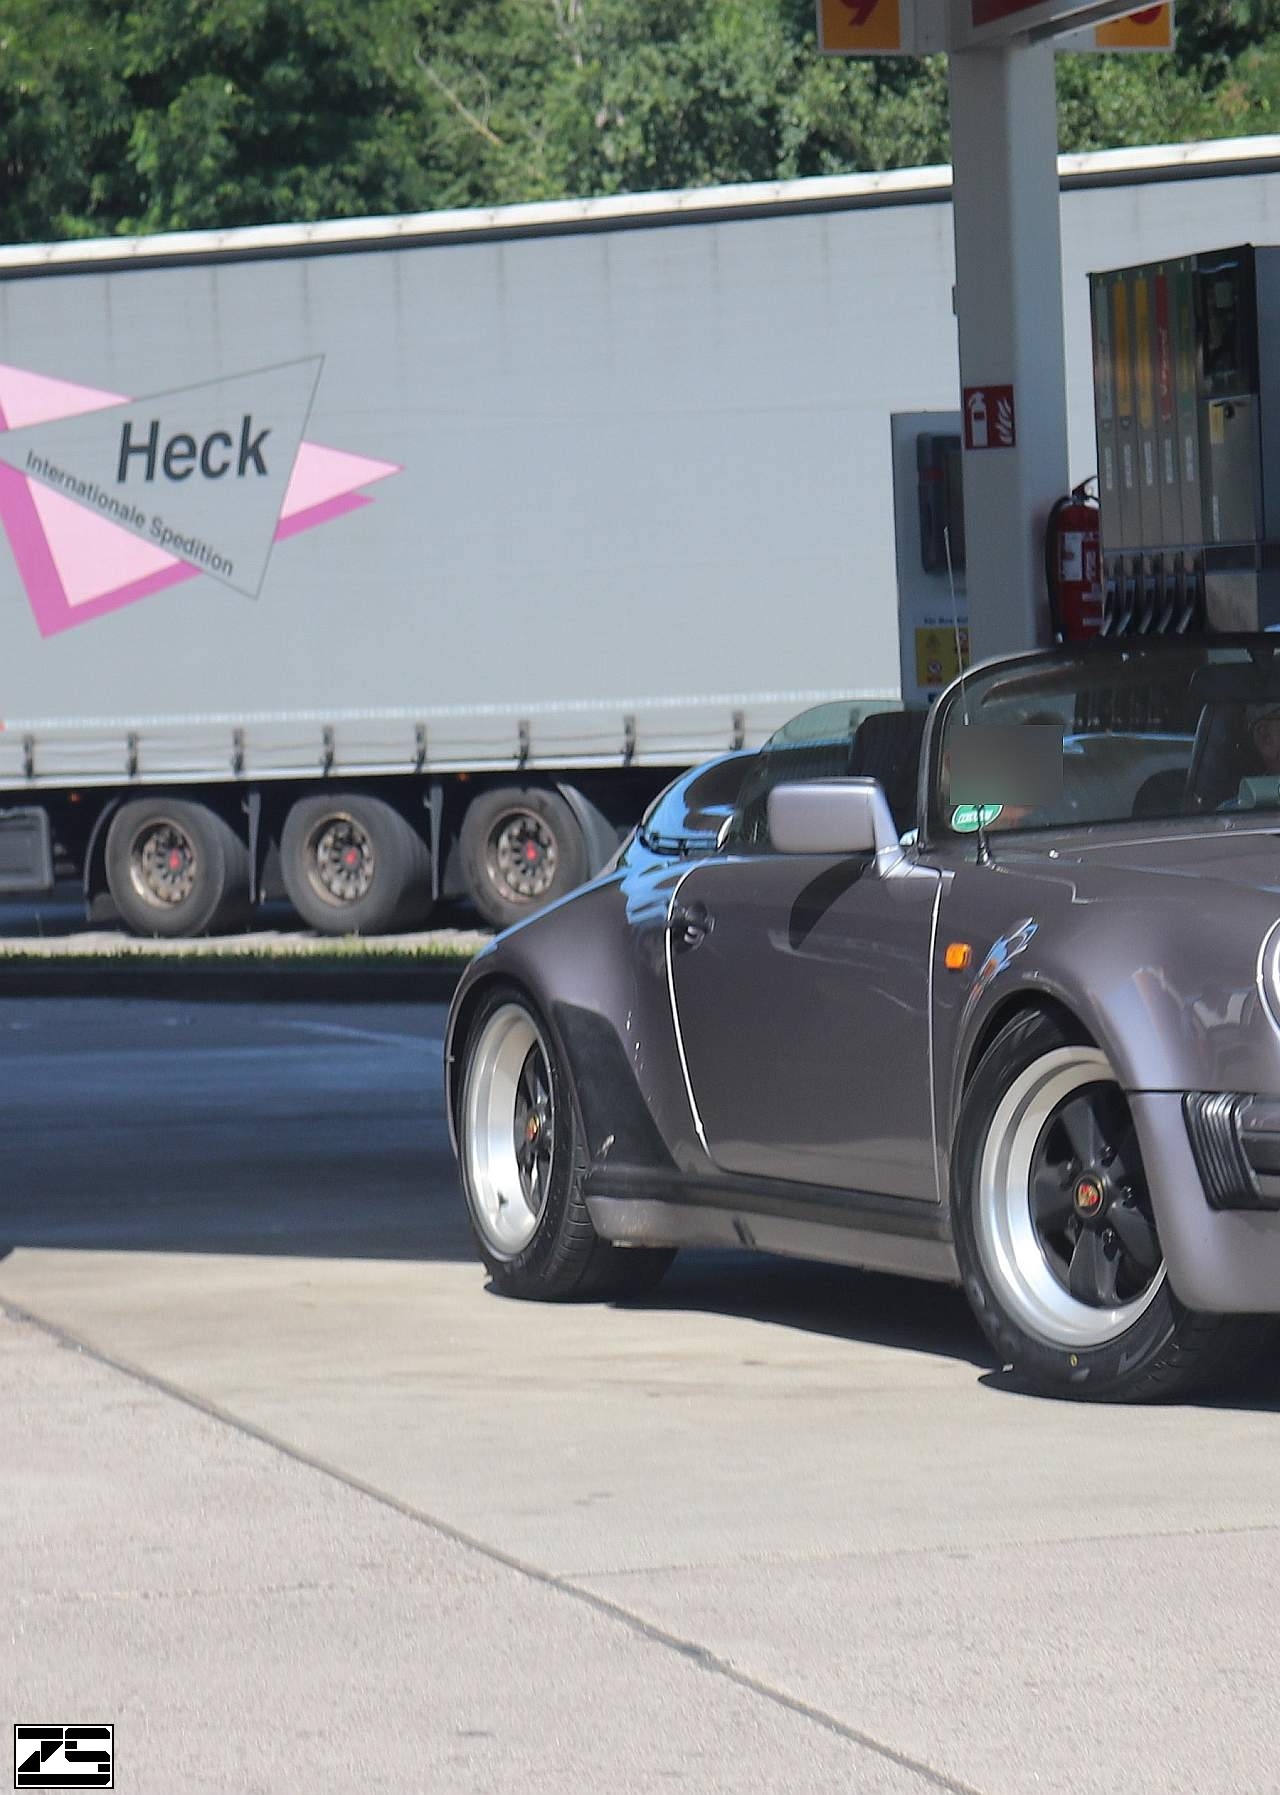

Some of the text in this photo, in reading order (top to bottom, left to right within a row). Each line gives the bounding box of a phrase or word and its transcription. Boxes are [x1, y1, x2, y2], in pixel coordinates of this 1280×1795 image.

[116, 414, 273, 485] Heck
[25, 448, 235, 577] Internationale Spedition
